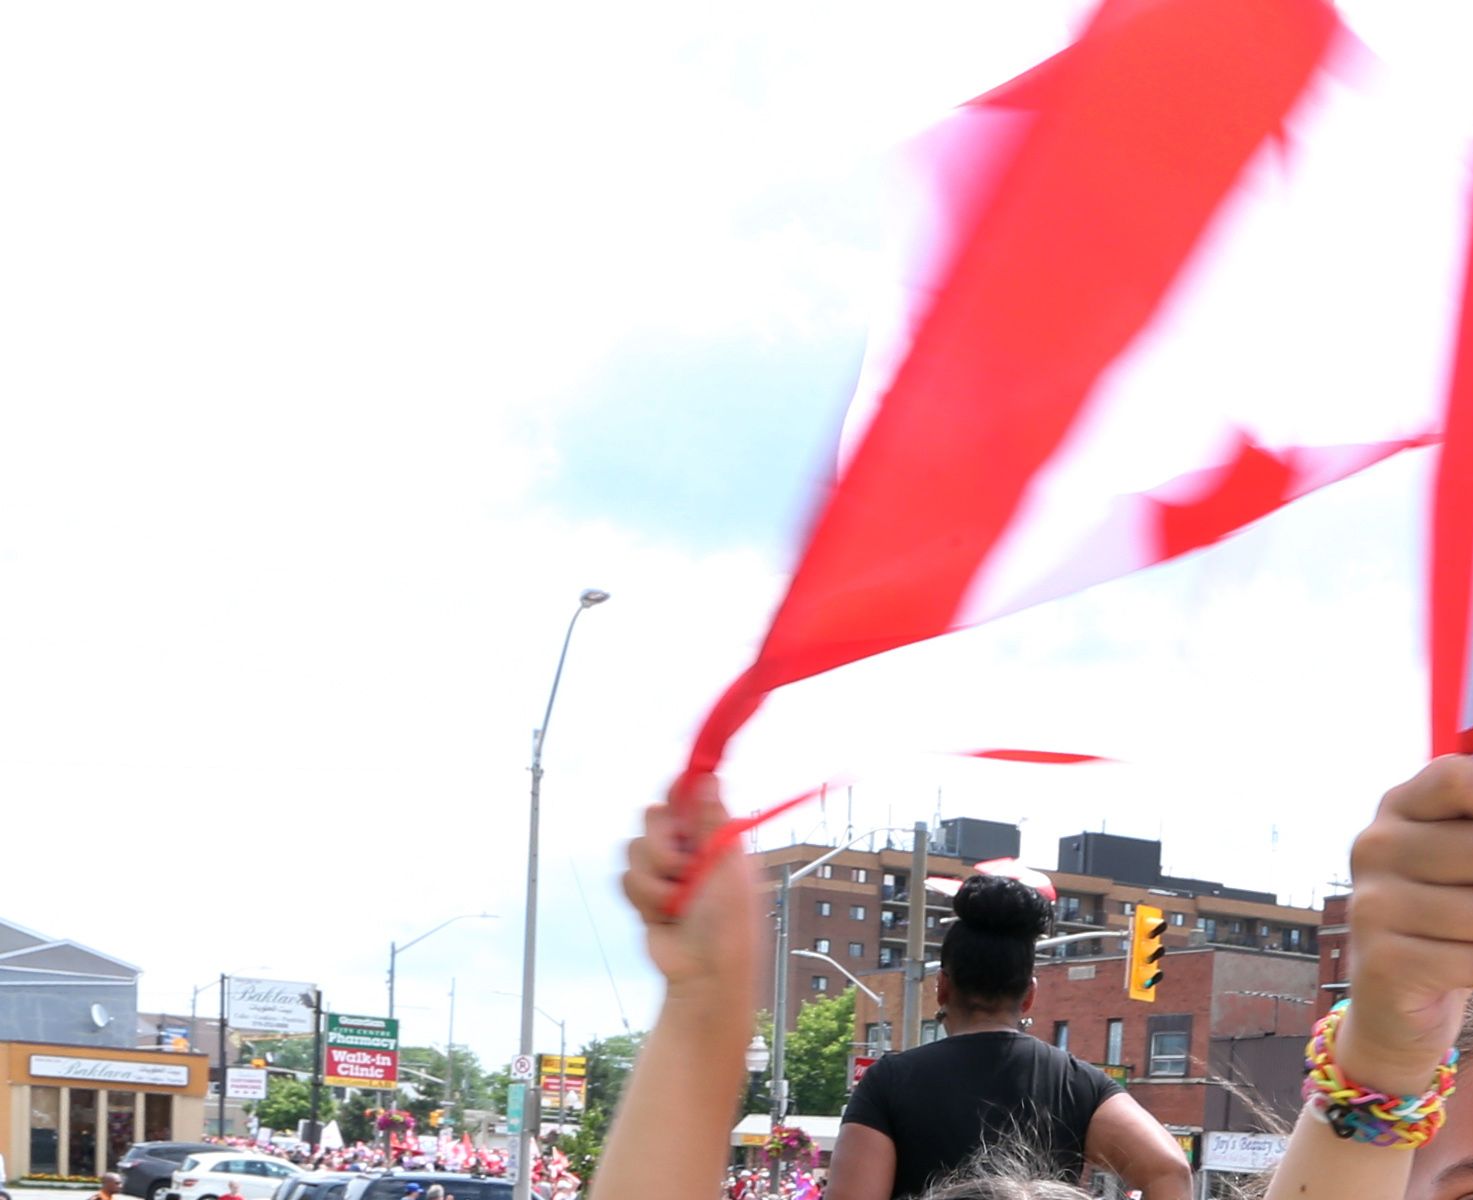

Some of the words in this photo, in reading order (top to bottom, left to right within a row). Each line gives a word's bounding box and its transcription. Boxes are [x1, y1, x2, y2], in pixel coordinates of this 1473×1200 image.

[328, 1032, 396, 1050] Pharmacy
[331, 1049, 392, 1067] Walk-in
[337, 1063, 385, 1079] Clinic
